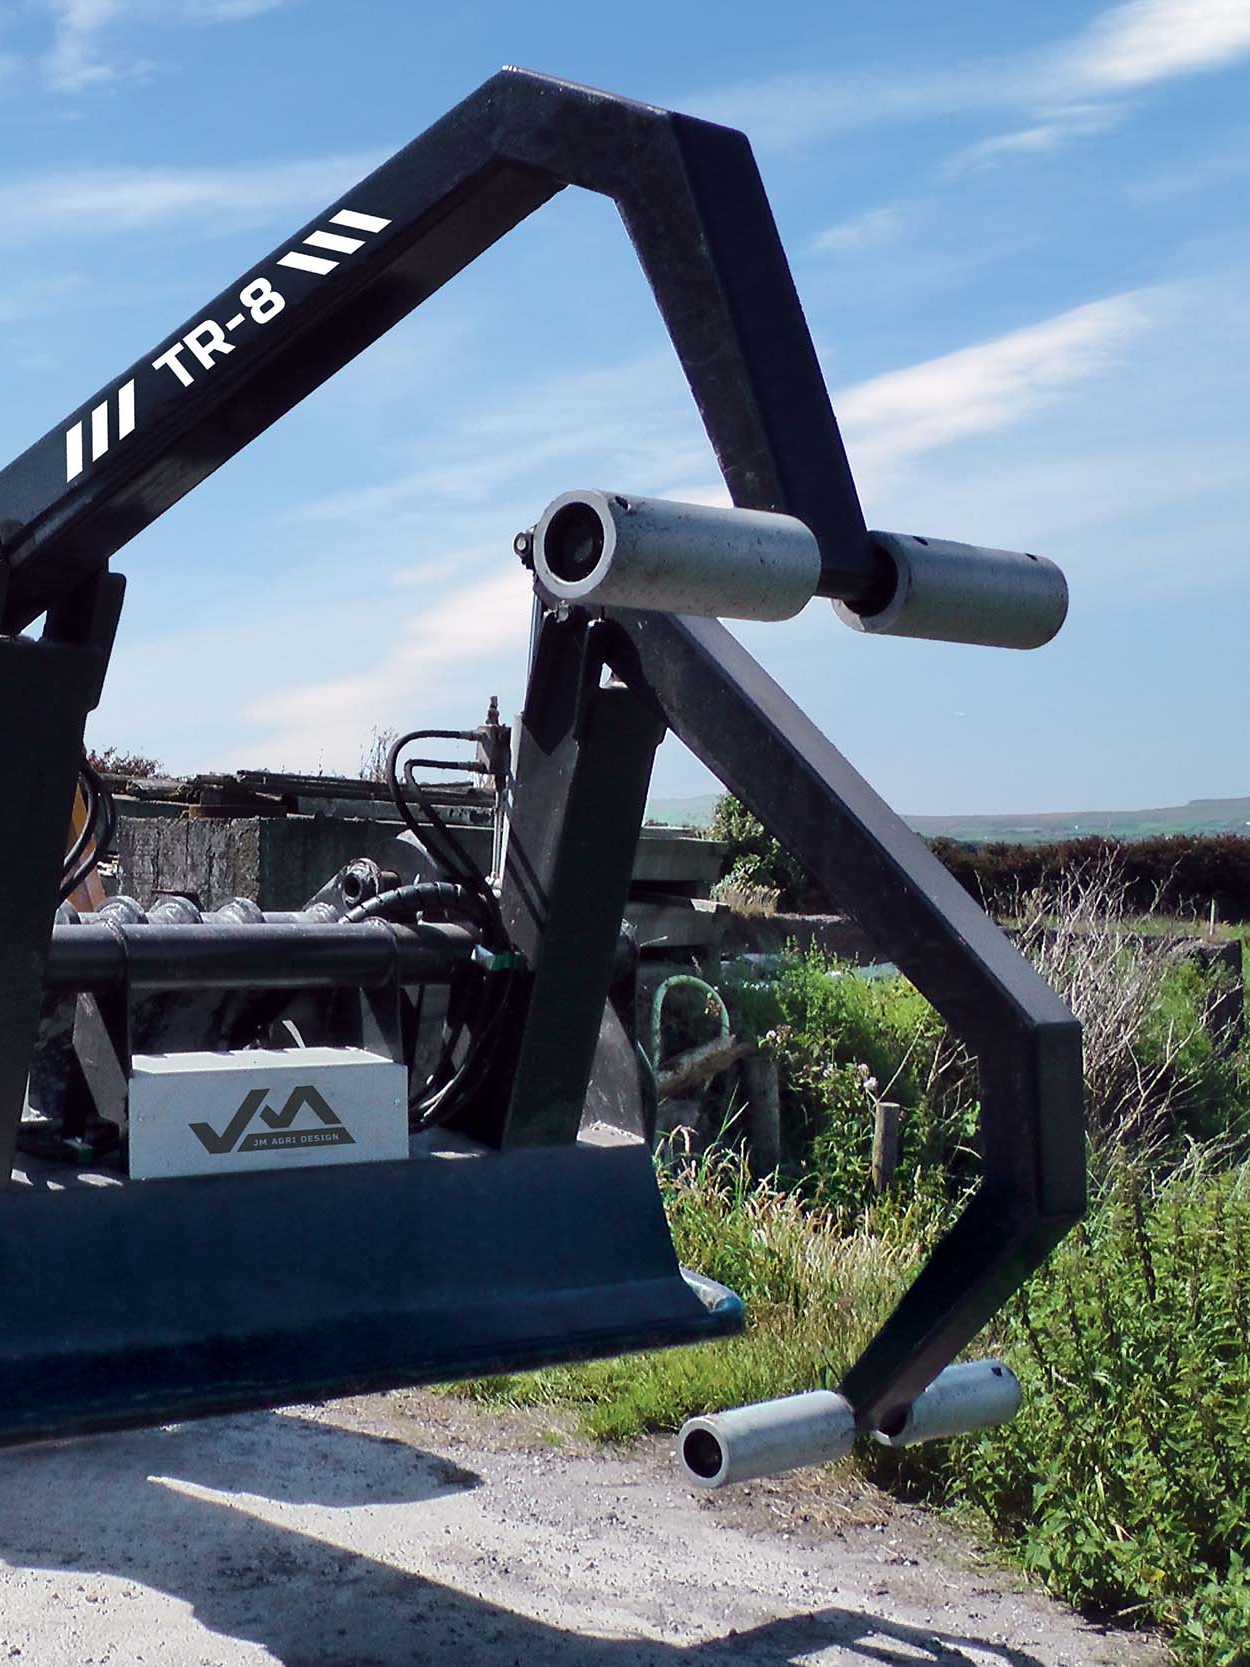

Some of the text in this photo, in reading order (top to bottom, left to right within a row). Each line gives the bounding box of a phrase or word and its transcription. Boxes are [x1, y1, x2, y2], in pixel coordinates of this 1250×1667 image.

[151, 277, 286, 388] TR-8
[253, 1133, 339, 1147] JM AGRI DESIGN
